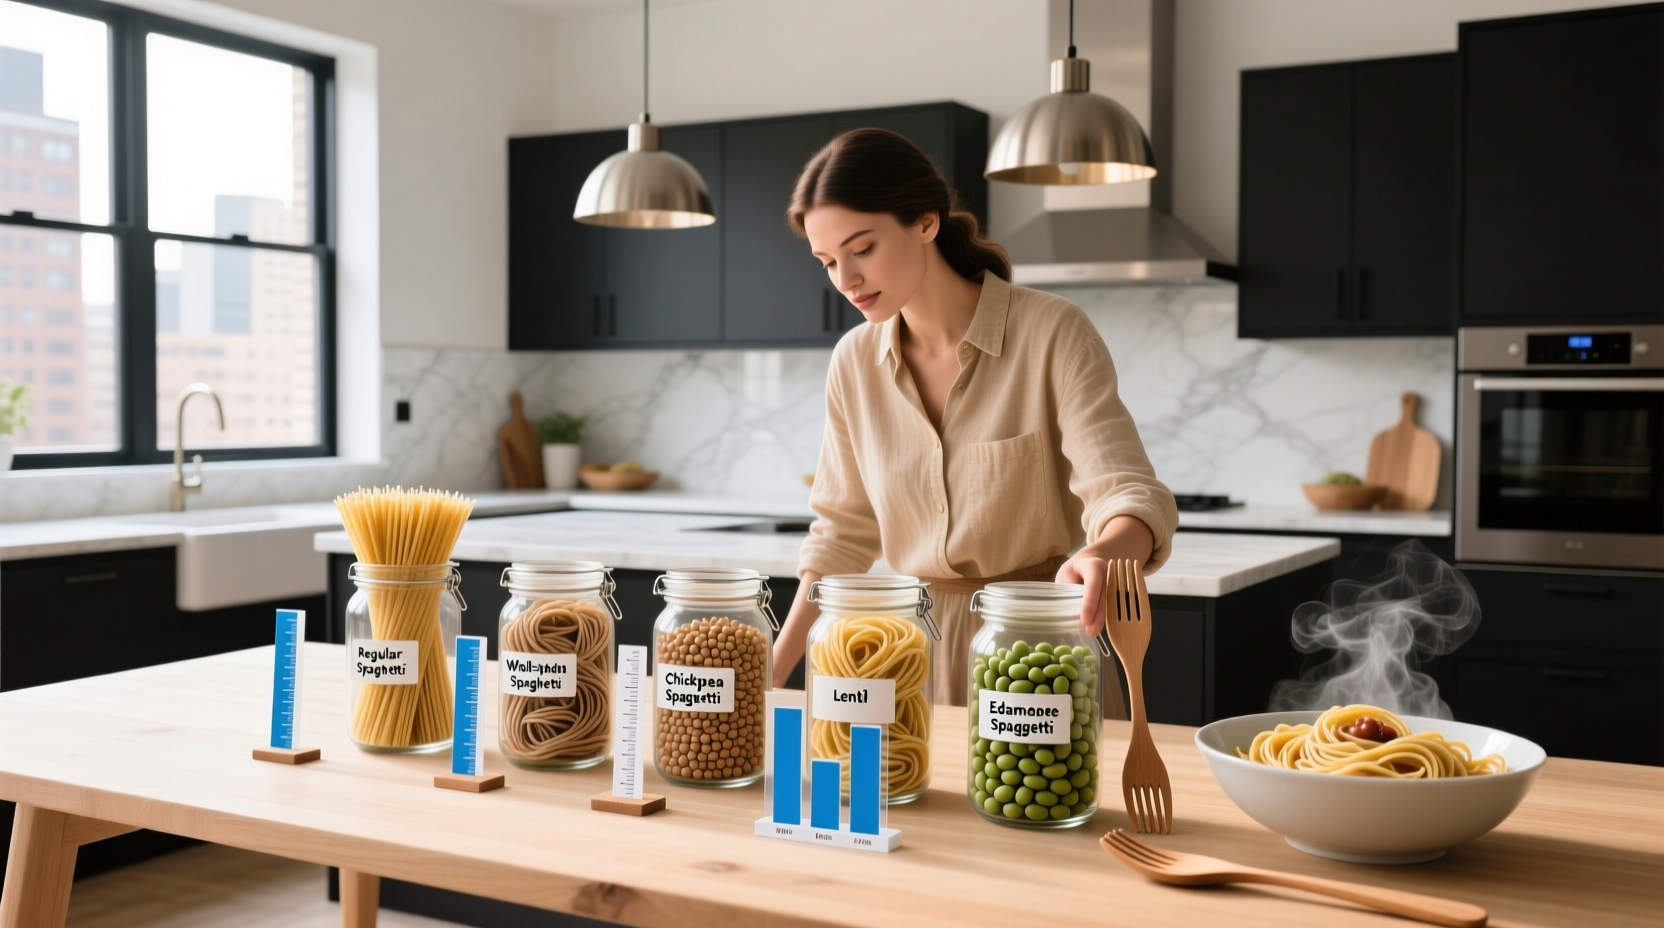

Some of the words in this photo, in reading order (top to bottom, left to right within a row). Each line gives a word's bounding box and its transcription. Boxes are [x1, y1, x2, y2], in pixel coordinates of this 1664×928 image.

[358, 646, 403, 663] Regular
[357, 662, 407, 678] Spaghetti
[665, 672, 724, 692] Chickpea
